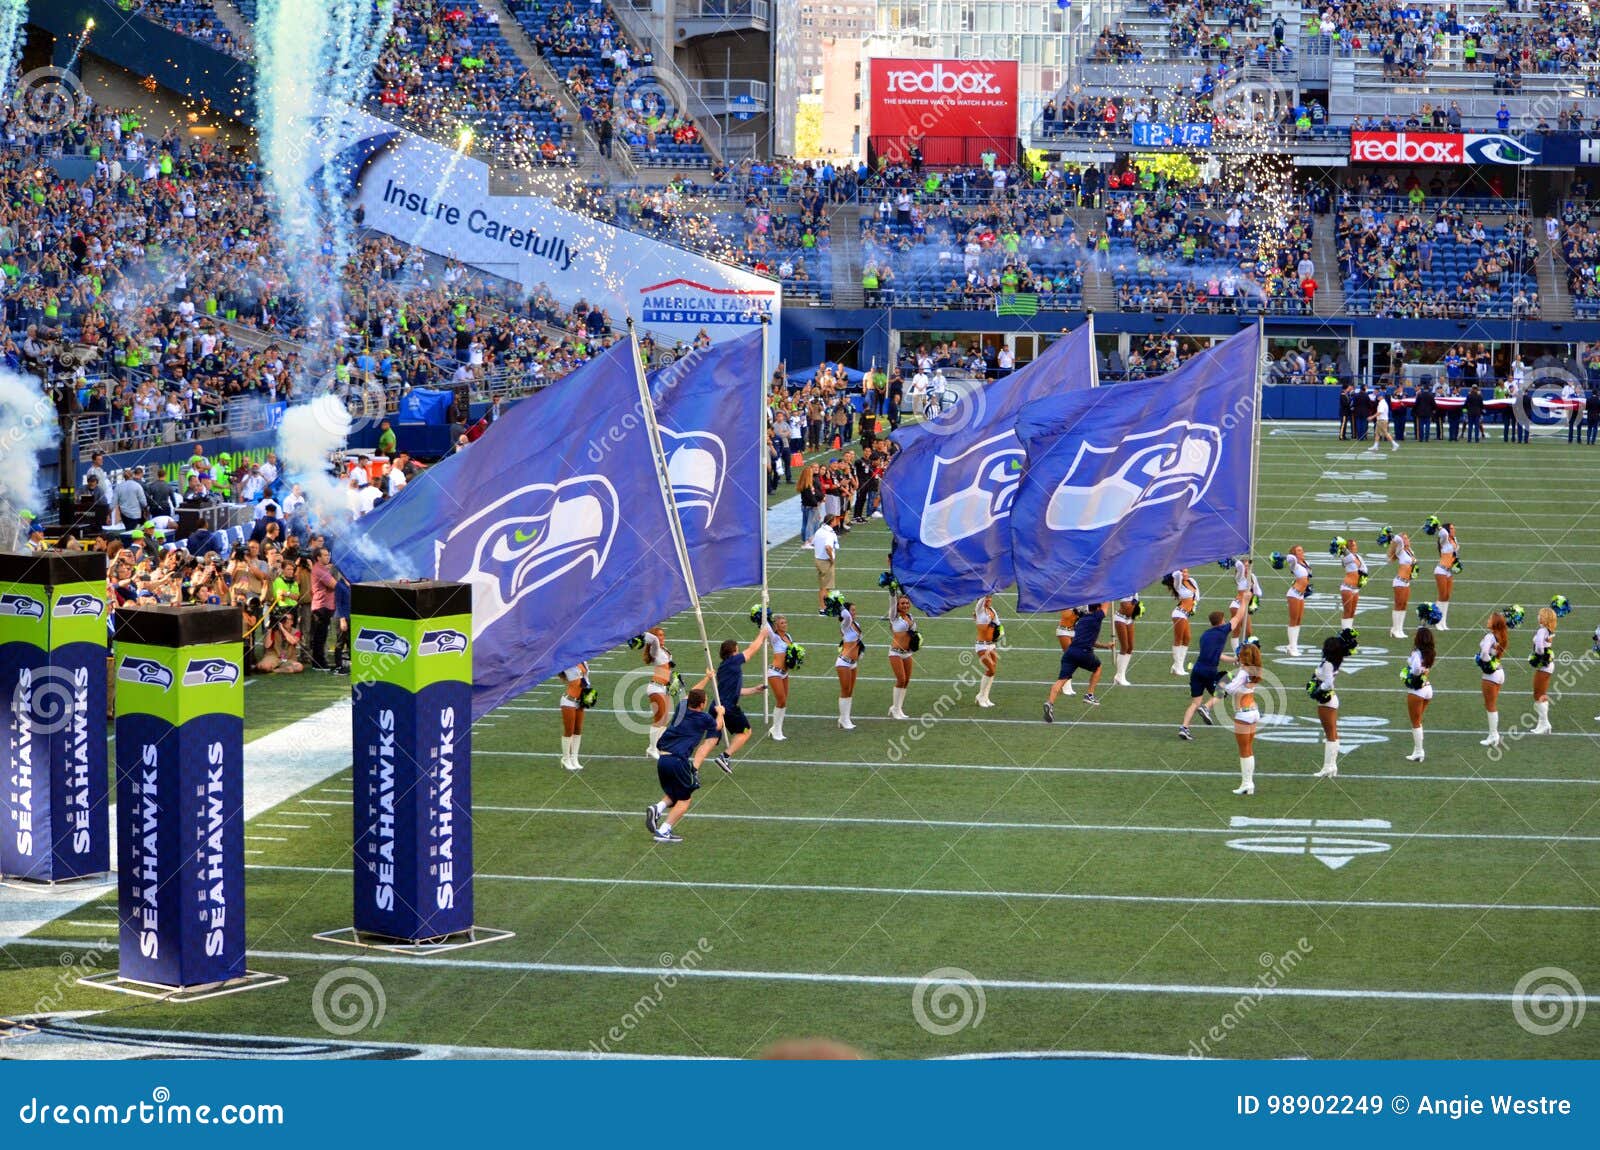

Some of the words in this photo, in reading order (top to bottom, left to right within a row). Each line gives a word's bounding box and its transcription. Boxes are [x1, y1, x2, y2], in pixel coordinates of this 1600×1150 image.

[1140, 124, 1163, 145] 12
[1181, 125, 1202, 144] 12
[383, 178, 461, 227] Insure
[467, 207, 580, 272] Carefully
[642, 297, 716, 310] AMERICAN
[721, 298, 773, 311] FAMILY
[651, 311, 762, 323] INSURANCE
[17, 667, 32, 856] SEAHAWKS
[73, 666, 91, 855] SEAHAWKS
[368, 744, 378, 873] SEATTLE
[375, 708, 395, 912] SEAHAWKS
[430, 746, 438, 877] SEATTLE
[436, 706, 455, 911] SEAHAWKS
[132, 782, 140, 919] SEATTLE
[140, 743, 159, 960] SEAHAWKS
[198, 784, 208, 922] SEATTLE
[205, 741, 225, 958] SEAHAWKS
